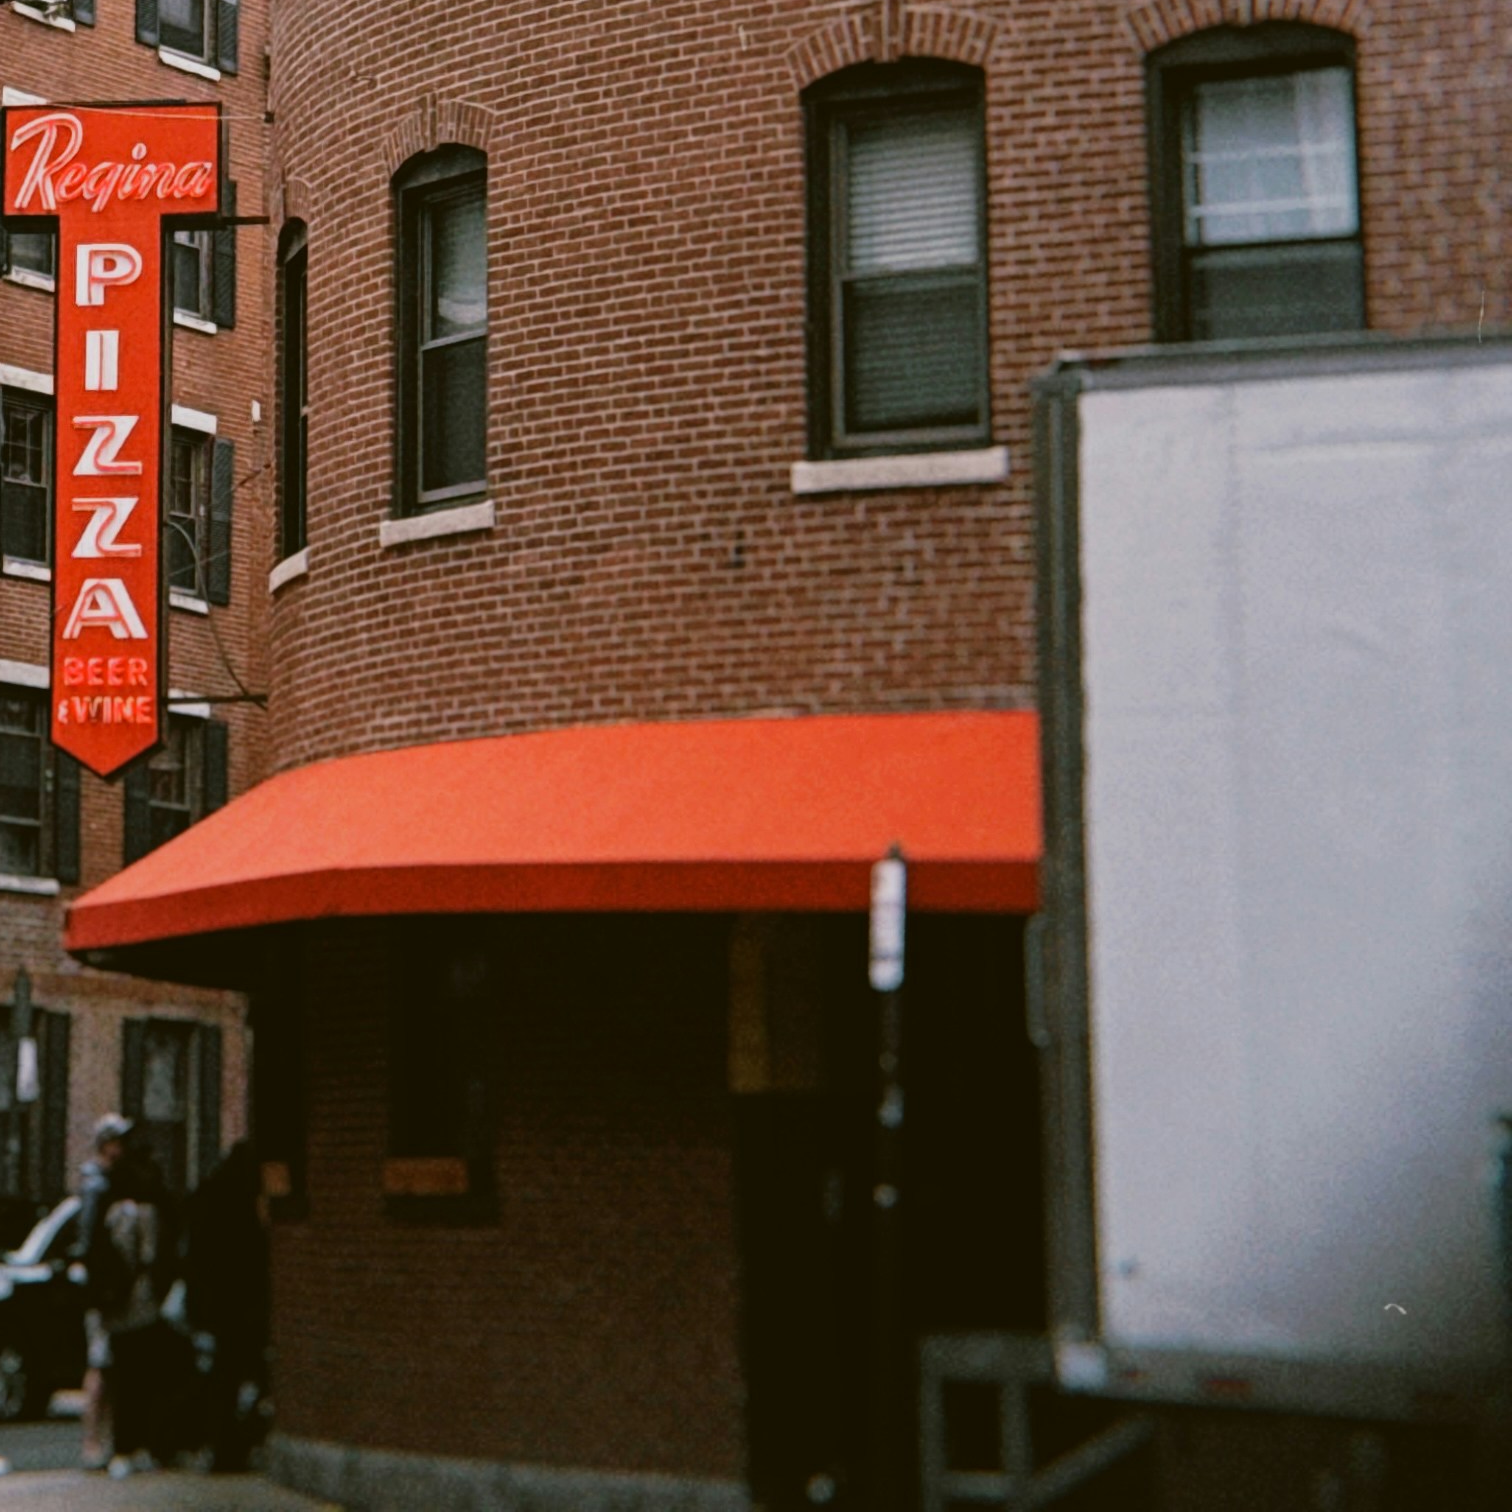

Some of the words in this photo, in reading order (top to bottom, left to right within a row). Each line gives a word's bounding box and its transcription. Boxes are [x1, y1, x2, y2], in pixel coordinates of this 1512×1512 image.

[11, 113, 213, 212] Regina
[63, 243, 148, 639] PIZZA
[63, 657, 148, 686] BEER
[71, 696, 153, 724] WINE
